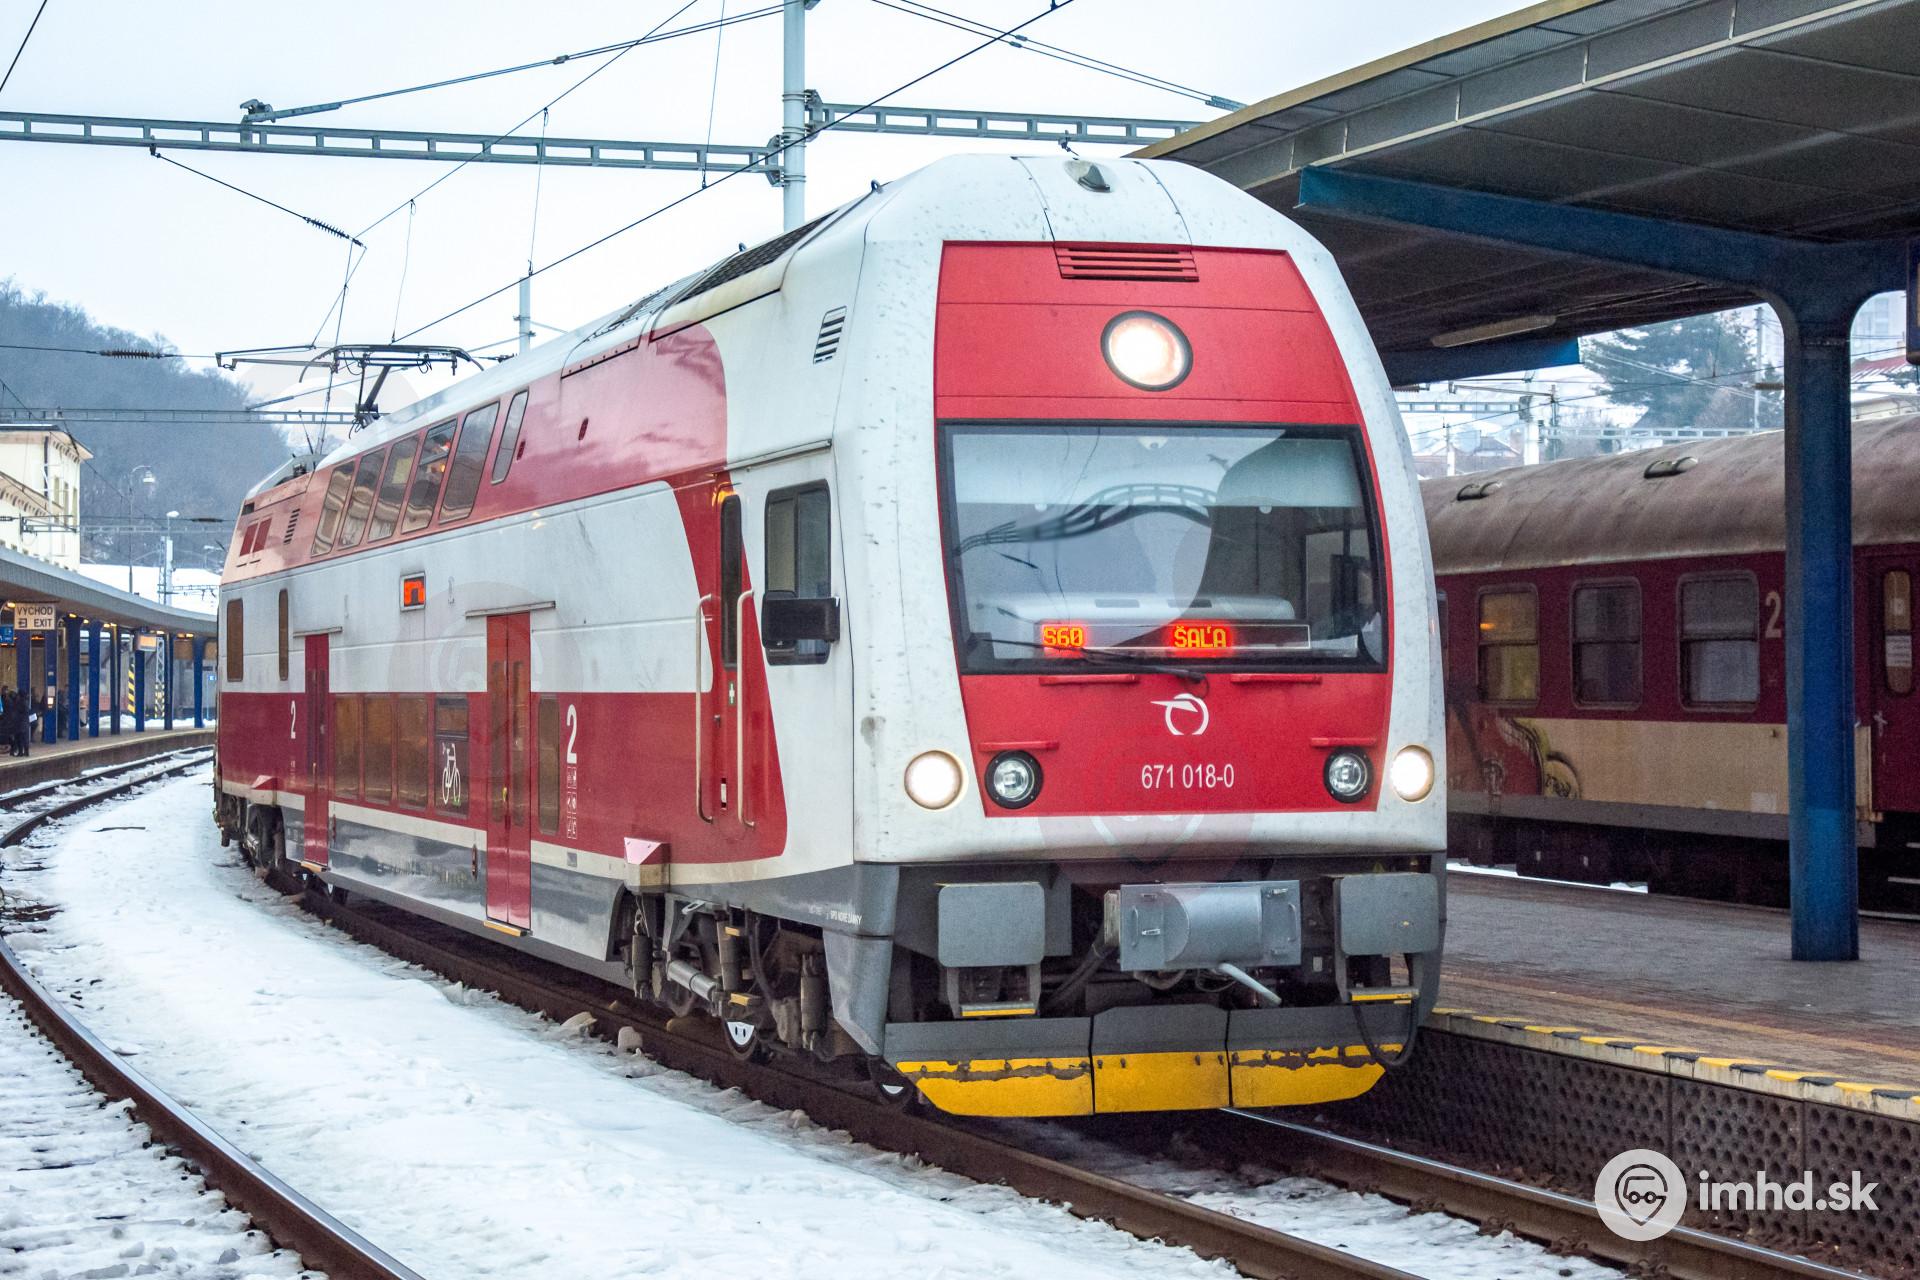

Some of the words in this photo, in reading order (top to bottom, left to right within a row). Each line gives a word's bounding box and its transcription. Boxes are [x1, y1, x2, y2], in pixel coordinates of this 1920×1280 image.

[34, 618, 52, 628] EXIT
[1765, 590, 1782, 639] 2
[1043, 626, 1084, 648] S60
[1173, 625, 1227, 648] ŠAĽA
[290, 700, 296, 739] 2
[566, 704, 577, 764] 2
[1141, 764, 1174, 789] 671
[1182, 763, 1235, 788] 018-0
